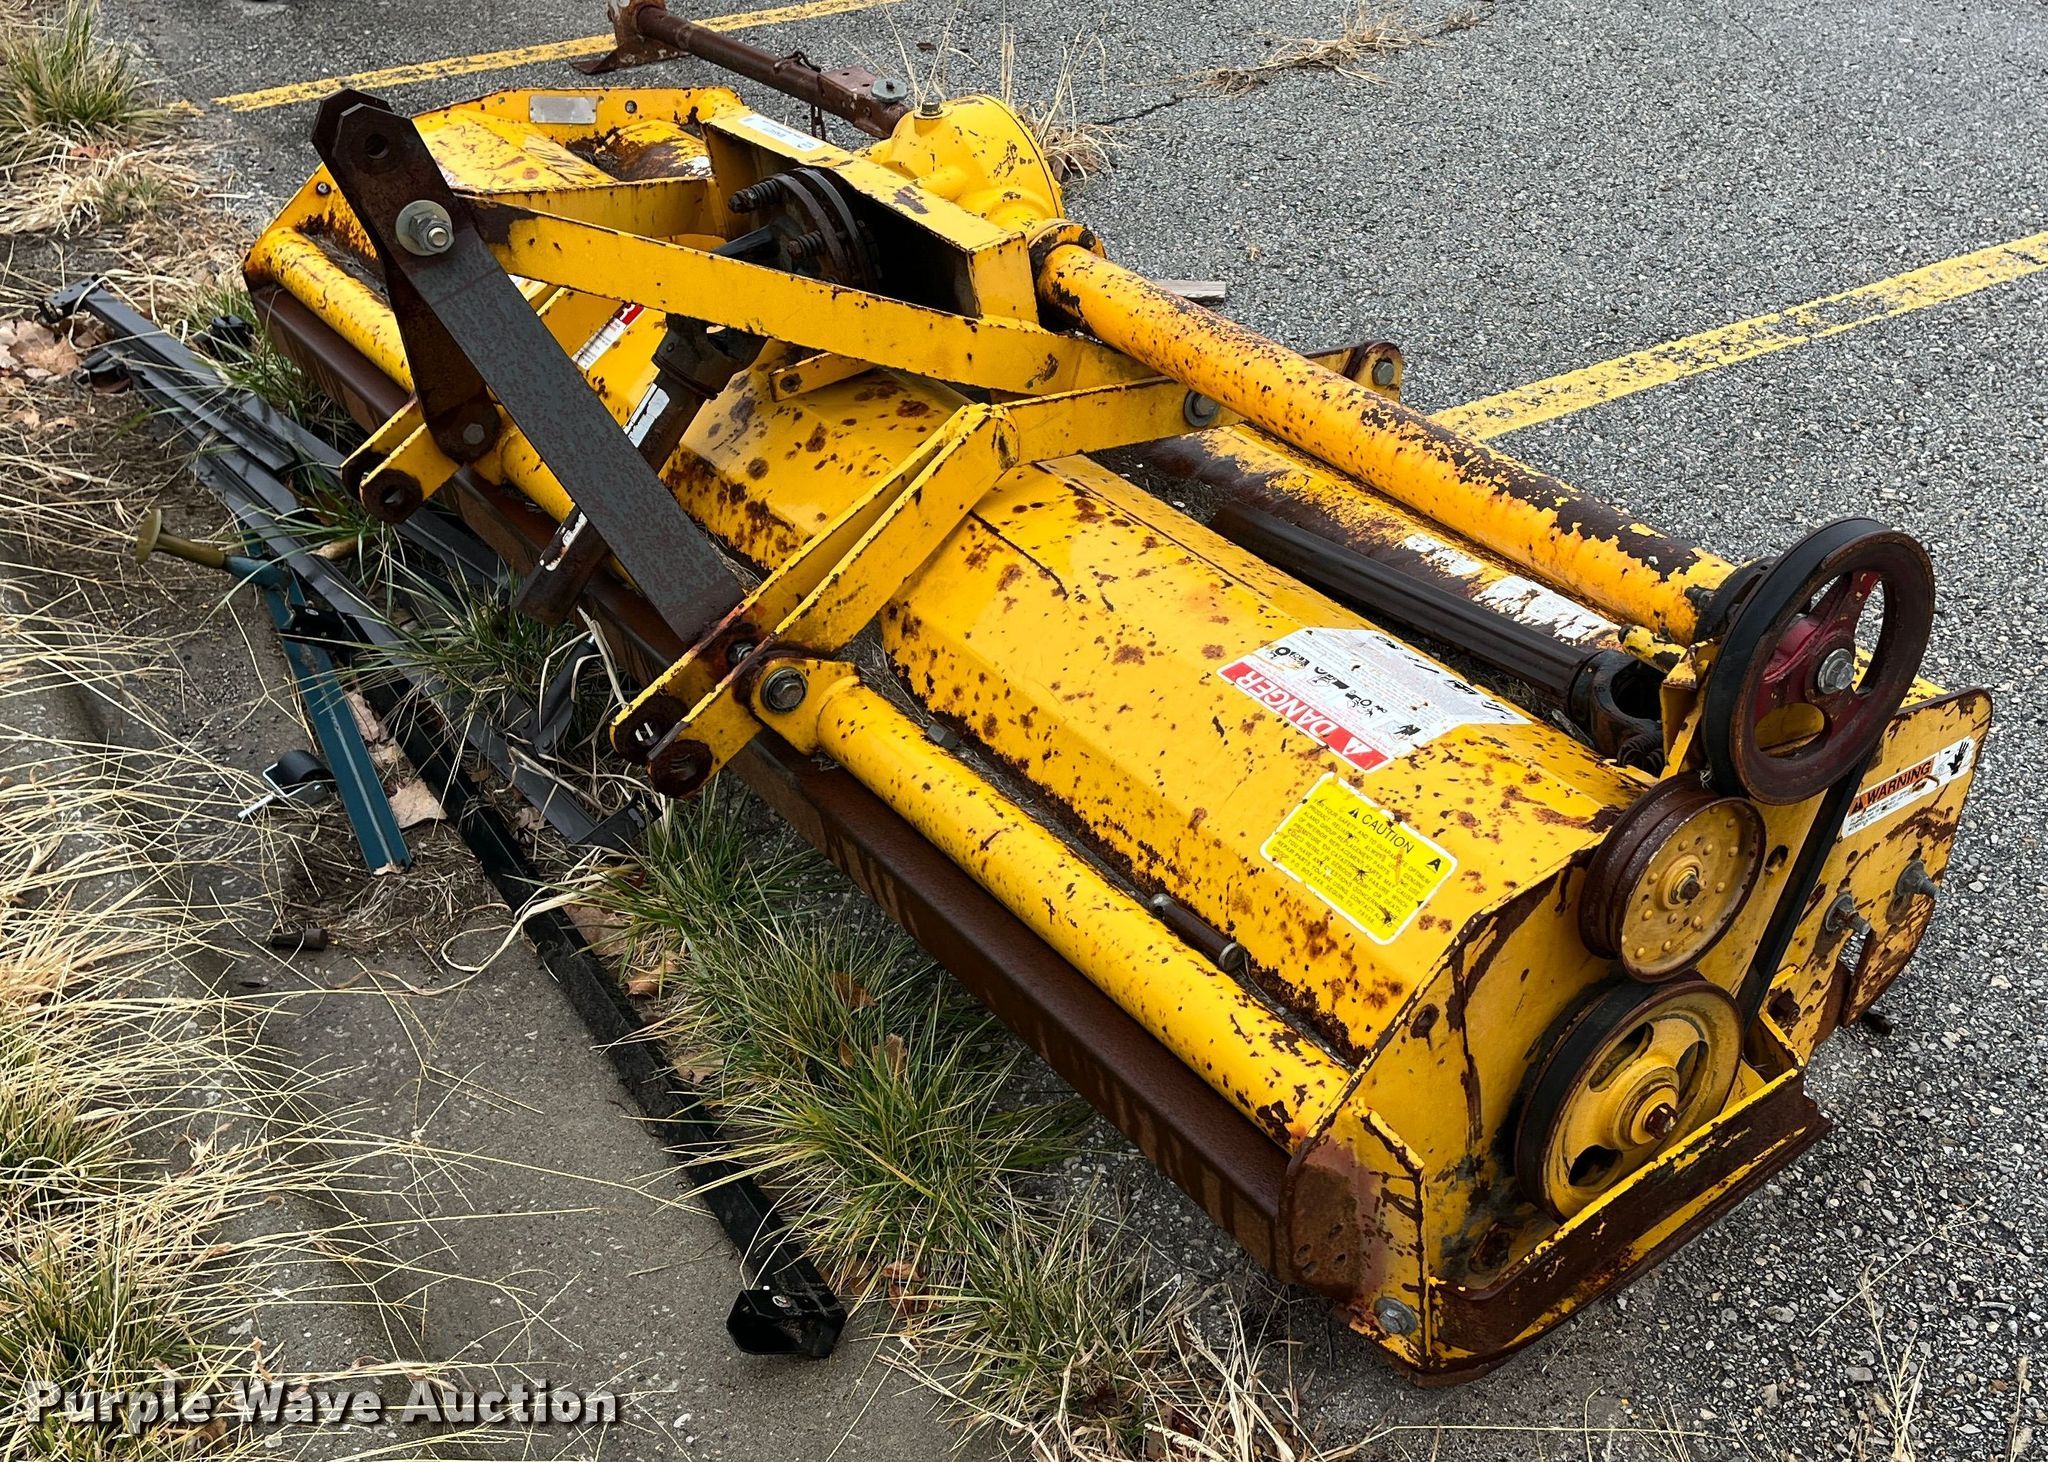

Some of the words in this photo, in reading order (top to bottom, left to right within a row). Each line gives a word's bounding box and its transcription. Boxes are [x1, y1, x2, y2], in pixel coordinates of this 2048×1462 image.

[1235, 670, 1339, 737] DANGER
[1867, 760, 1932, 804] WARNING
[1361, 814, 1415, 854] CAUTION
